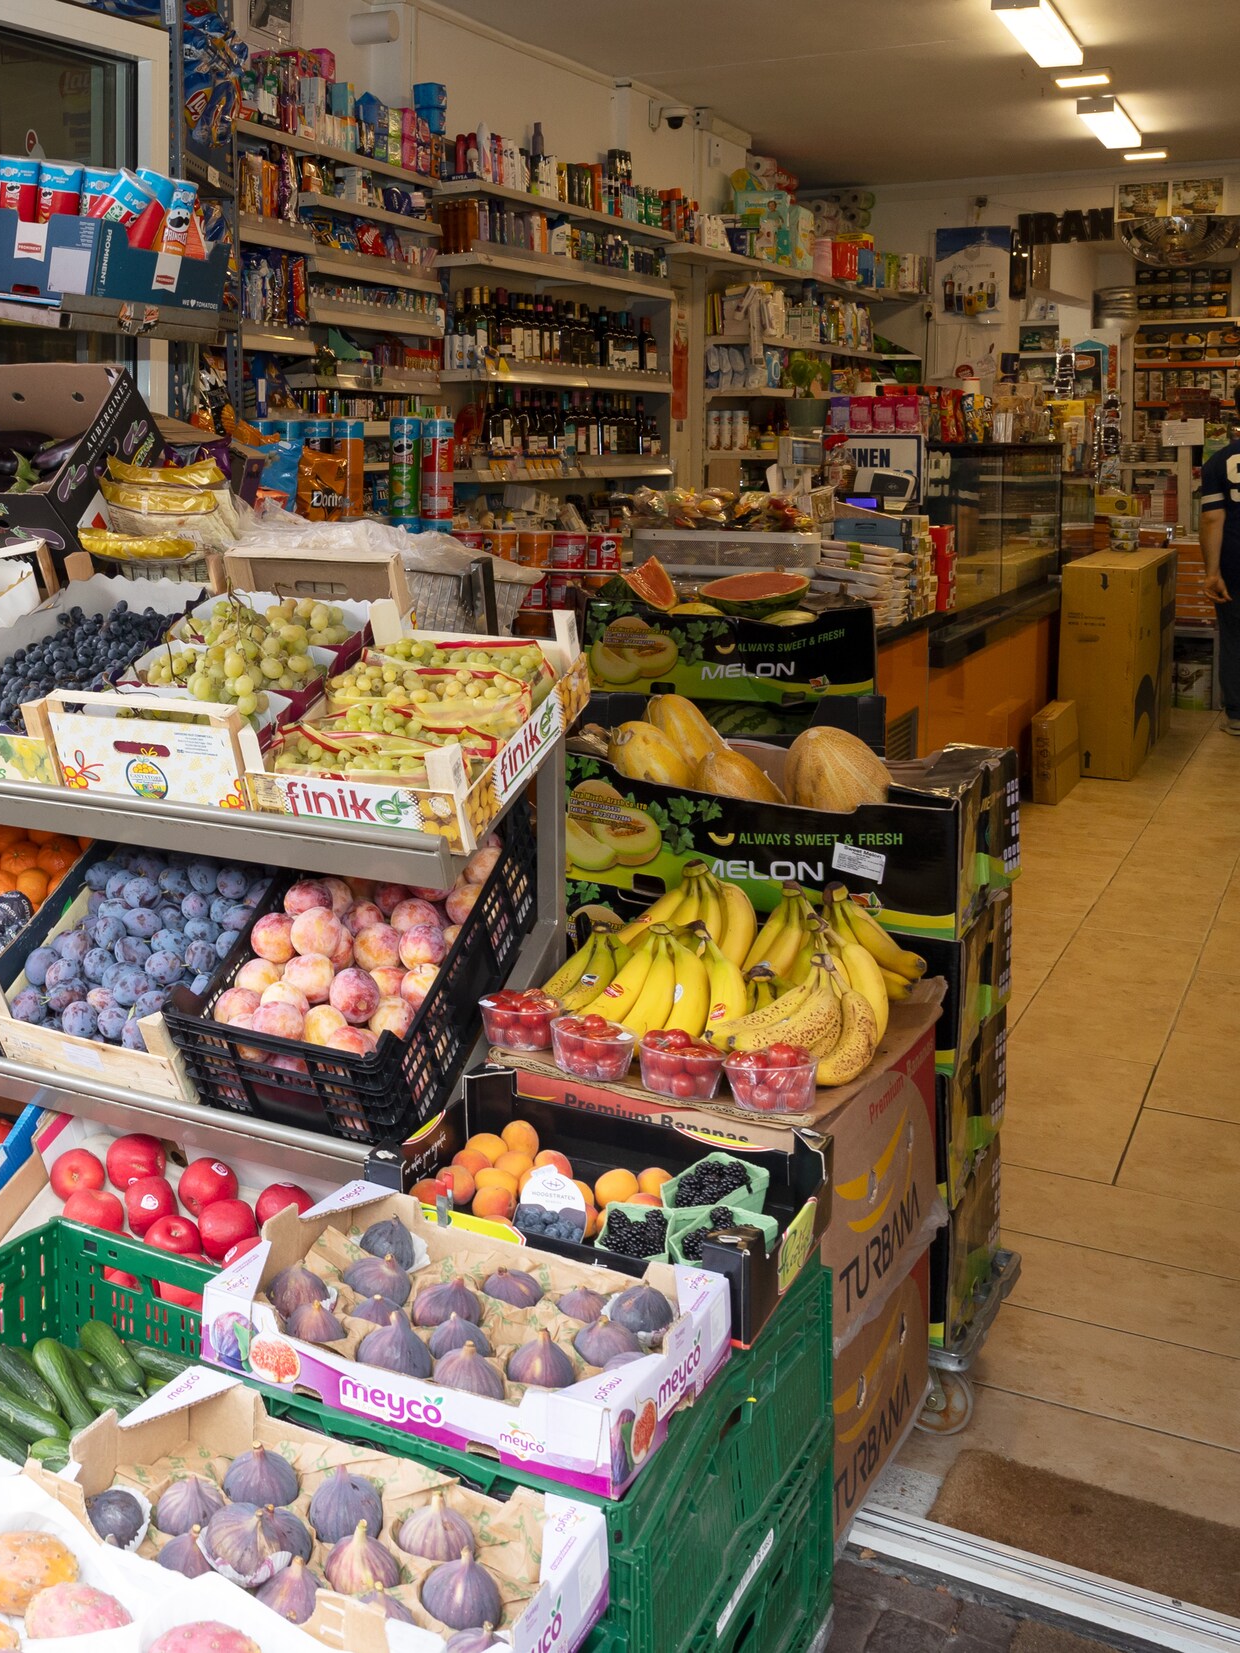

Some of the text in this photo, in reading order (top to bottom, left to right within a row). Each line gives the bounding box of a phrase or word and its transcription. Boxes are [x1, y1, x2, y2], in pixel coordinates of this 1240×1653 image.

[1018, 207, 1115, 246] IRAN
[100, 229, 113, 286] PROMINENT
[87, 379, 129, 452] AUBERGINES
[738, 628, 845, 653] ALWAYS SWEET & FRESH
[701, 661, 795, 680] MELON
[501, 702, 556, 794] finike
[285, 781, 415, 825] finike
[739, 832, 903, 846] ALWAYS SWEET & FRESH
[710, 860, 824, 881] MELON
[905, 1043, 935, 1078] Bananas
[563, 1092, 653, 1125] Premium
[869, 1075, 904, 1123] Premium
[531, 1190, 576, 1201] HOOGSTRATEN
[839, 1181, 920, 1313] TURBANA
[166, 1371, 200, 1402] meyco
[658, 1344, 701, 1409] meyco
[342, 1377, 443, 1425] meyco
[499, 1431, 546, 1456] meyco
[833, 1371, 912, 1518] TURBANA
